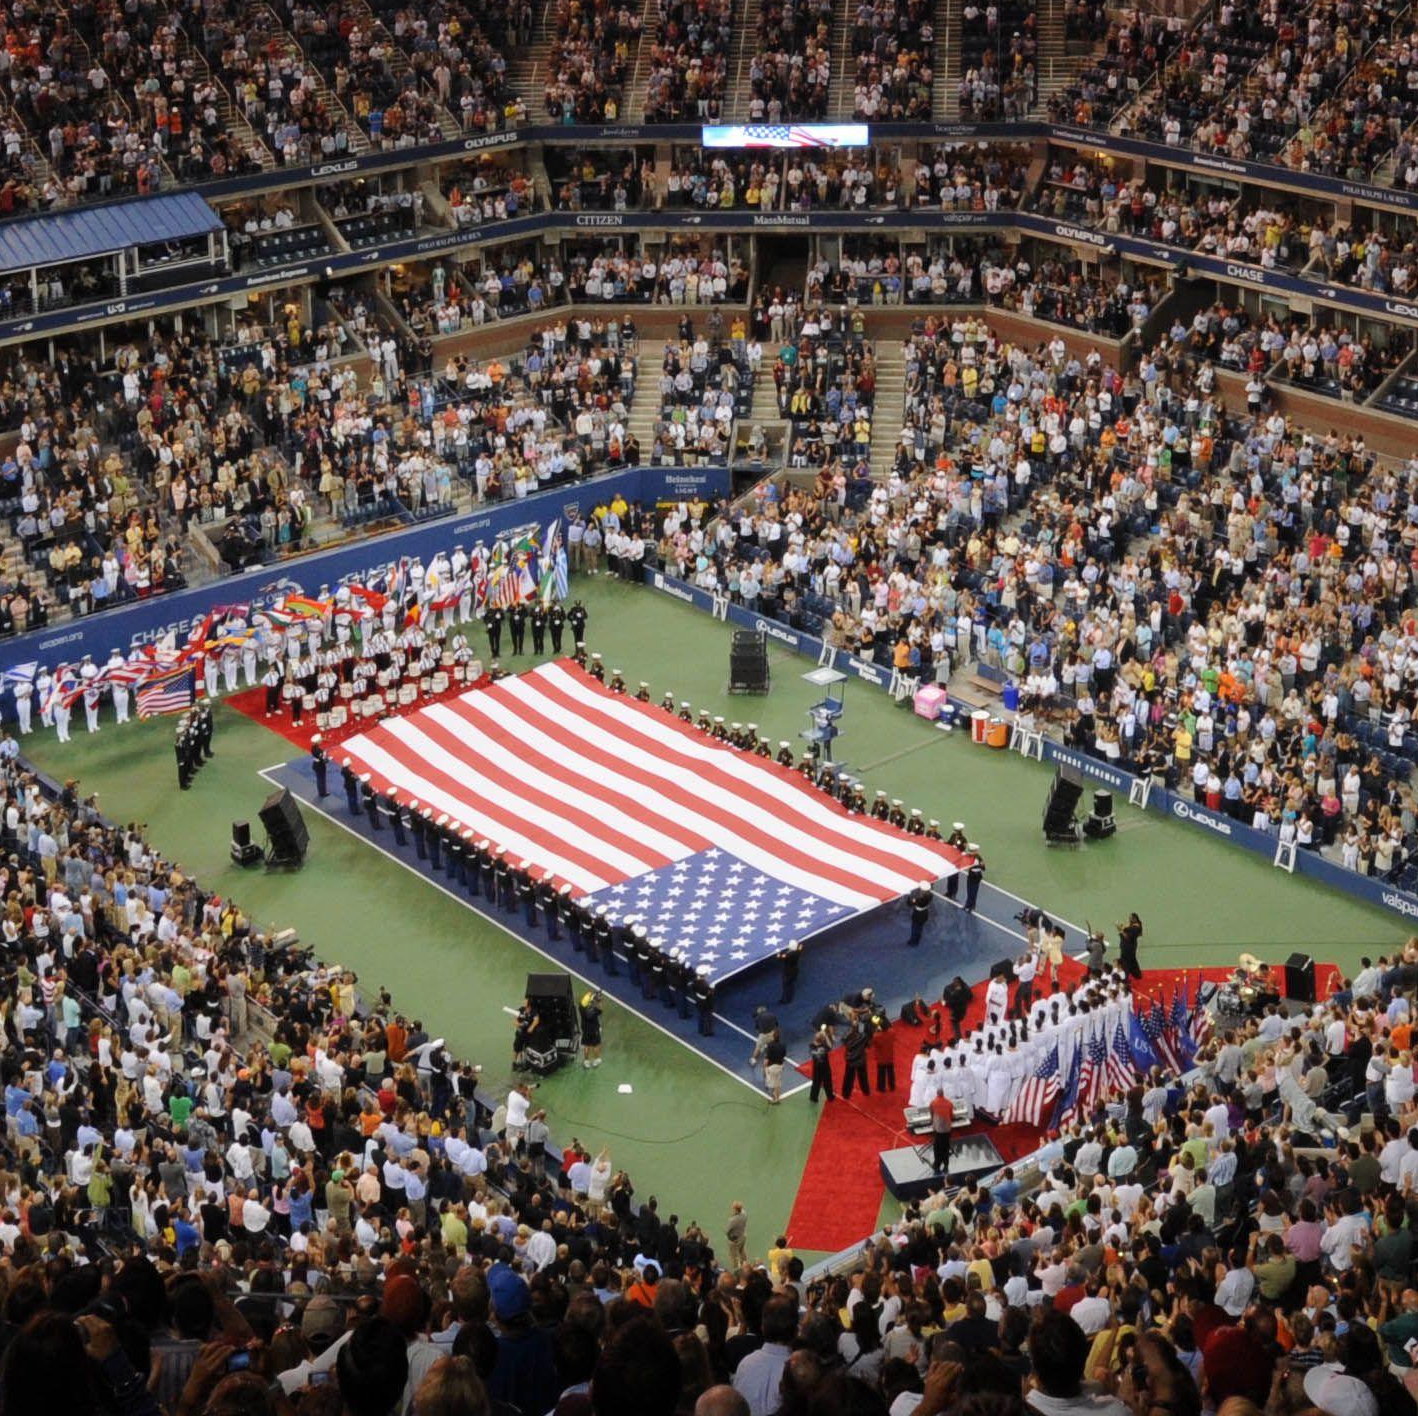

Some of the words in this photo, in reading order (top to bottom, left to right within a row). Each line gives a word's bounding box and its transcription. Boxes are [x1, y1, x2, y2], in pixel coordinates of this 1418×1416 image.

[464, 132, 518, 150] OLYMPUS
[310, 161, 358, 176] LEXUS
[576, 215, 623, 226] CITIZEN
[753, 215, 810, 225] MassMutual
[1055, 225, 1106, 245] OLYMPUS
[246, 273, 281, 286] American
[280, 268, 309, 280] Express
[1226, 264, 1265, 284] CHASE
[665, 475, 708, 484] Heineken
[38, 631, 84, 650] usopen.org
[132, 619, 190, 644] CHASE
[767, 625, 799, 645] LEXUS
[1188, 809, 1232, 835] LEXUS
